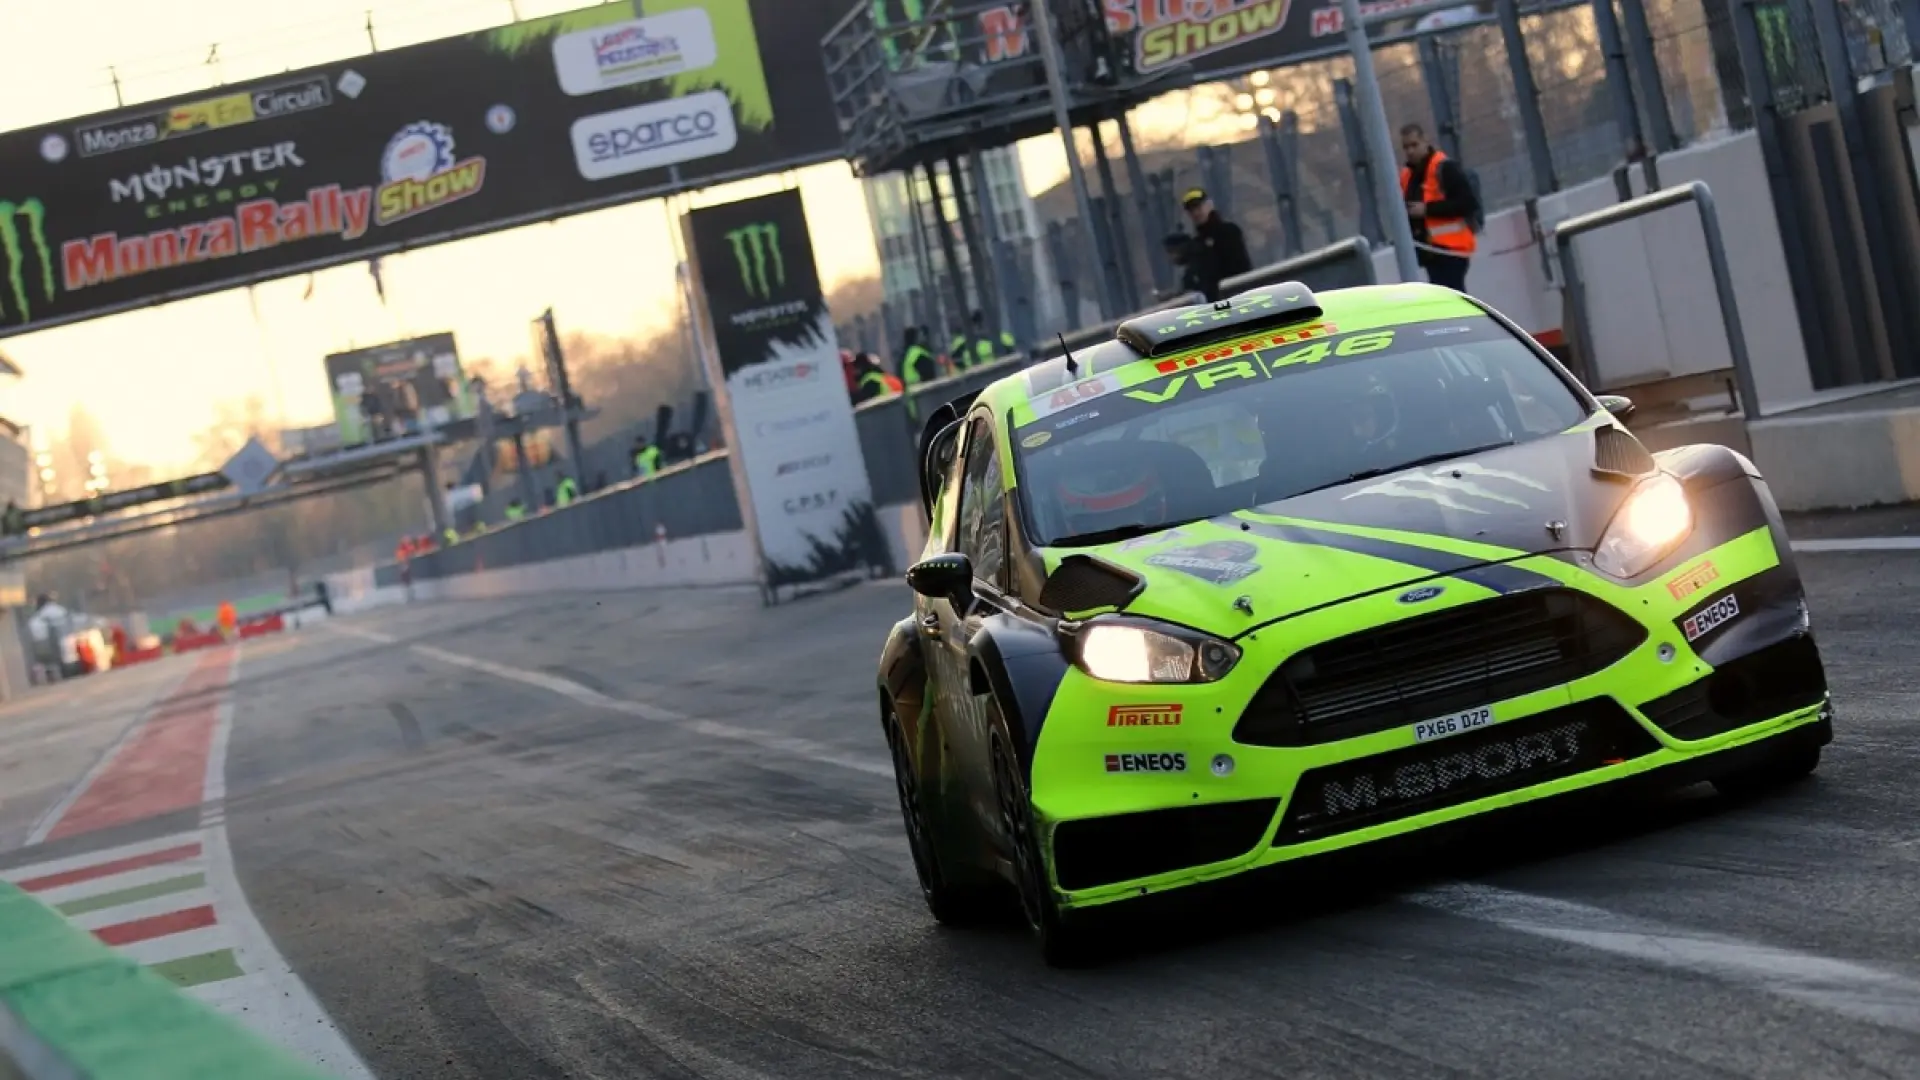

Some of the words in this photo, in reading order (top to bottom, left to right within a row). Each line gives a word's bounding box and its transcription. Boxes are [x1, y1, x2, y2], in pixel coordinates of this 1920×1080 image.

[1140, 1, 1284, 68] Show
[81, 122, 158, 152] Monza
[254, 85, 325, 115] Circuit
[588, 110, 716, 158] sparco
[108, 140, 307, 203] MONSTER
[378, 160, 484, 222] Show
[1122, 361, 1258, 403] VR
[1271, 331, 1396, 368] 46
[1407, 588, 1435, 601] Ford
[1696, 596, 1737, 633] ENEOS
[1106, 703, 1183, 728] PIRELLI
[1416, 717, 1457, 740] PX66
[1461, 709, 1490, 732] DZP
[1121, 753, 1186, 773] ENEOS
[1323, 720, 1588, 816] M-SPORT
